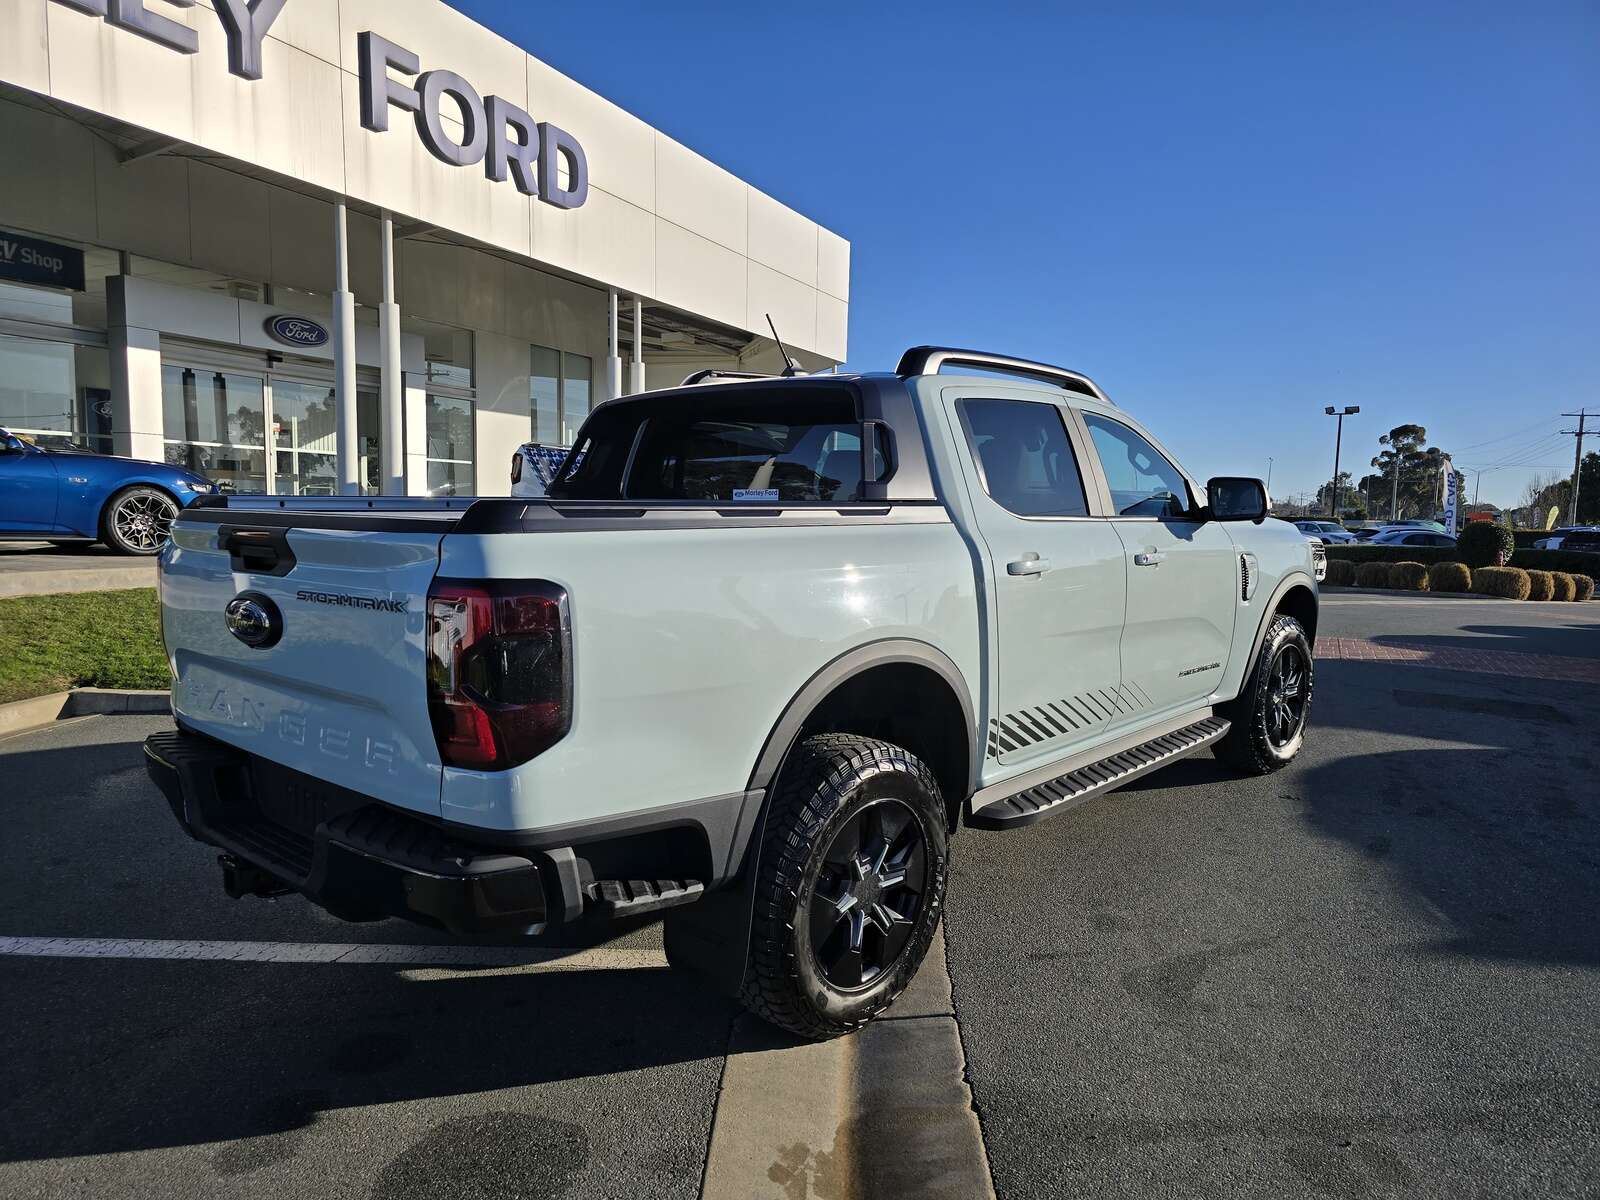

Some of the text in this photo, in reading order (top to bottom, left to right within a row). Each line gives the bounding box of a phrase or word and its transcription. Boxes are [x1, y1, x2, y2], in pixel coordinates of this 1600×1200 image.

[357, 31, 588, 209] FORD
[0, 240, 63, 272] V Shop
[286, 322, 318, 341] Ford
[745, 489, 764, 497] Morley
[296, 590, 409, 614] STORMTRAK
